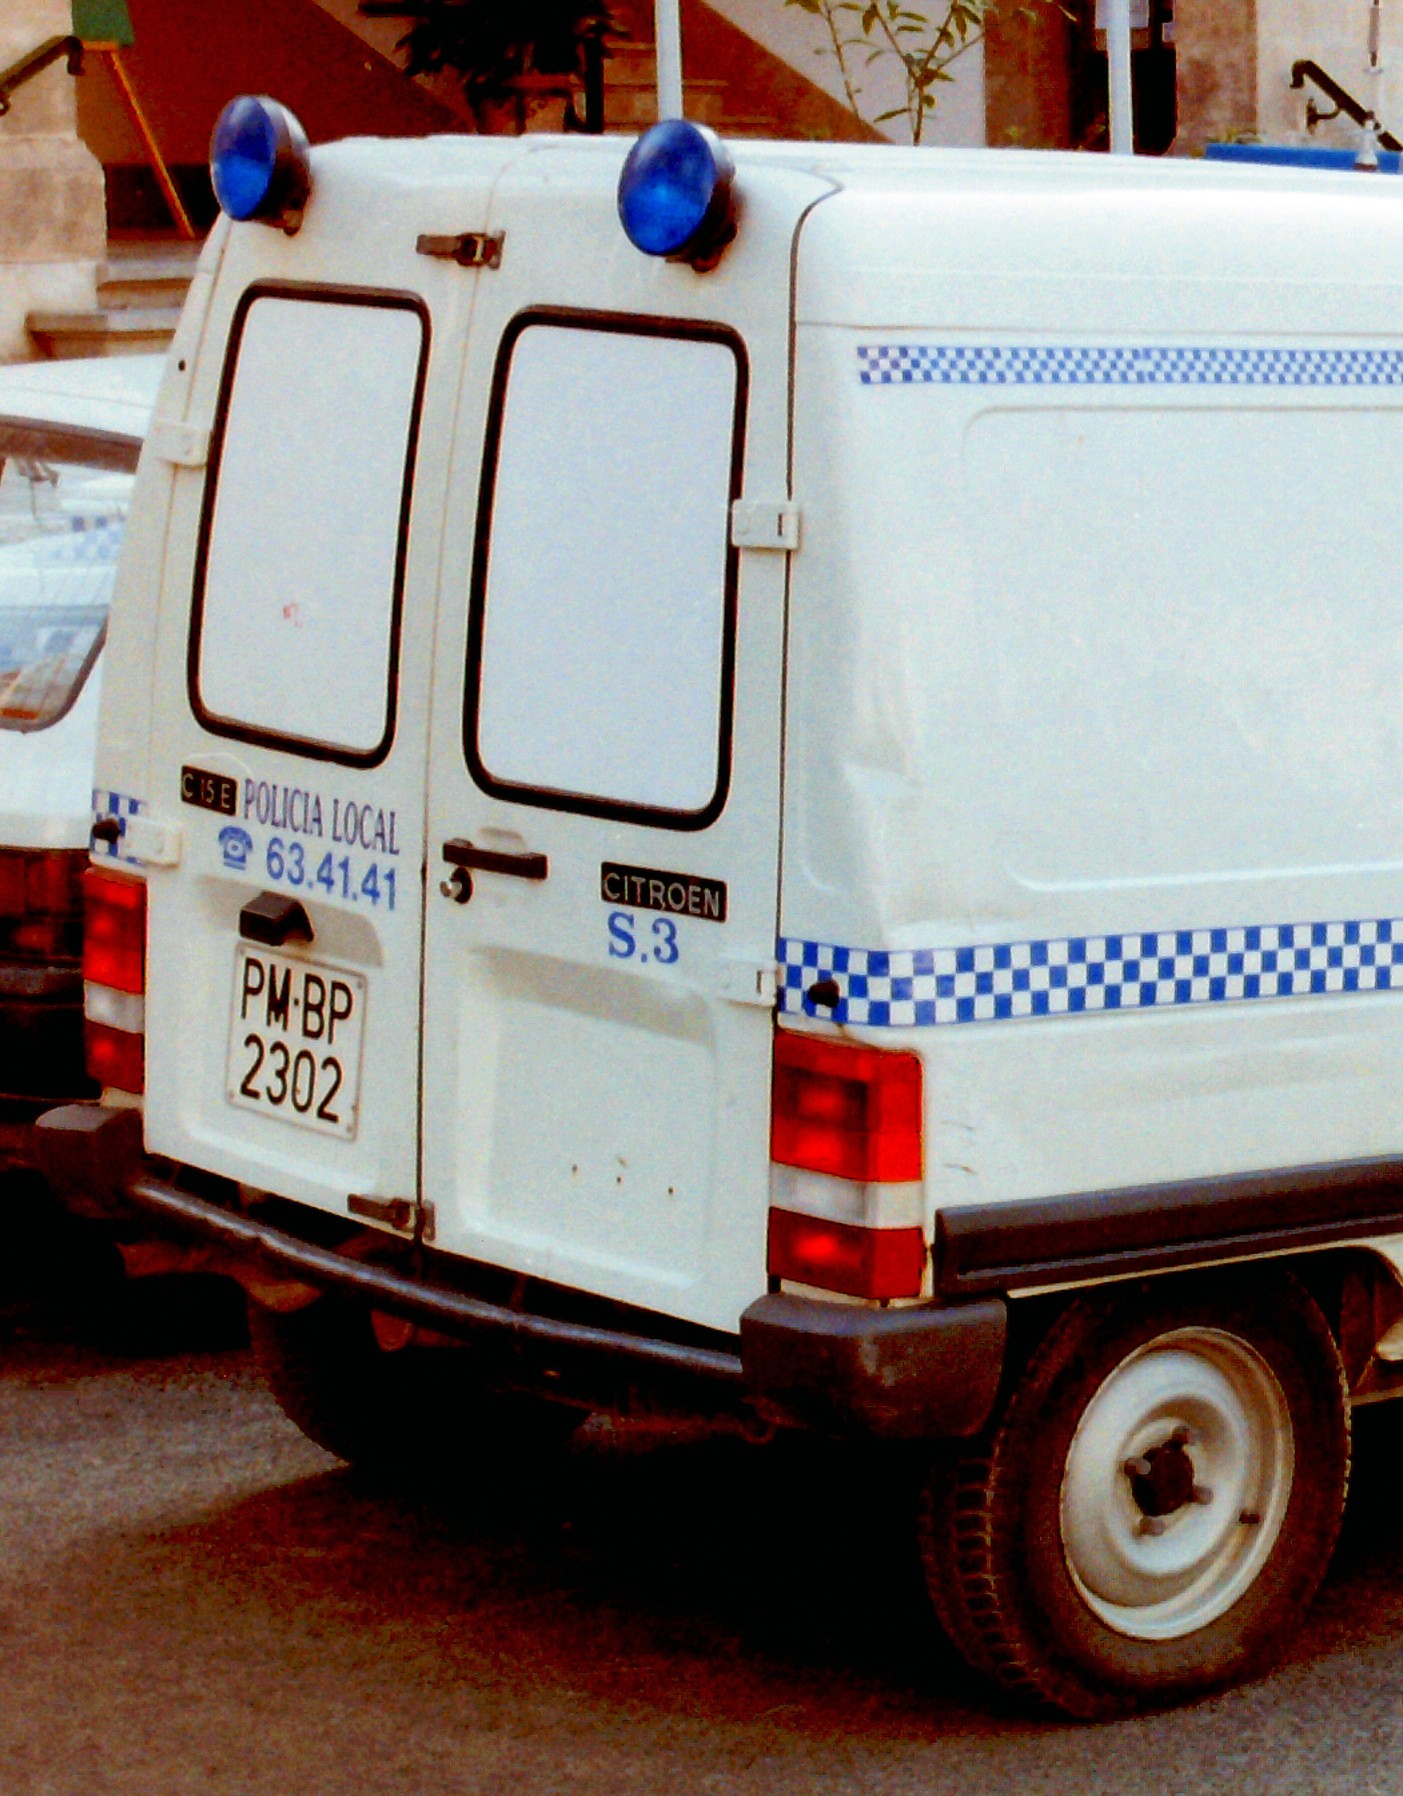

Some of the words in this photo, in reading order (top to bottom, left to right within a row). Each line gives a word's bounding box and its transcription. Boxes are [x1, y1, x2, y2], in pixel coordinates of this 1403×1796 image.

[245, 777, 323, 837] POLICIA
[332, 798, 399, 856] LOCAL
[266, 837, 396, 911] 63.41.41
[604, 872, 719, 917] CITROEN
[607, 910, 679, 964] S.3
[240, 1033, 343, 1123] 2302
